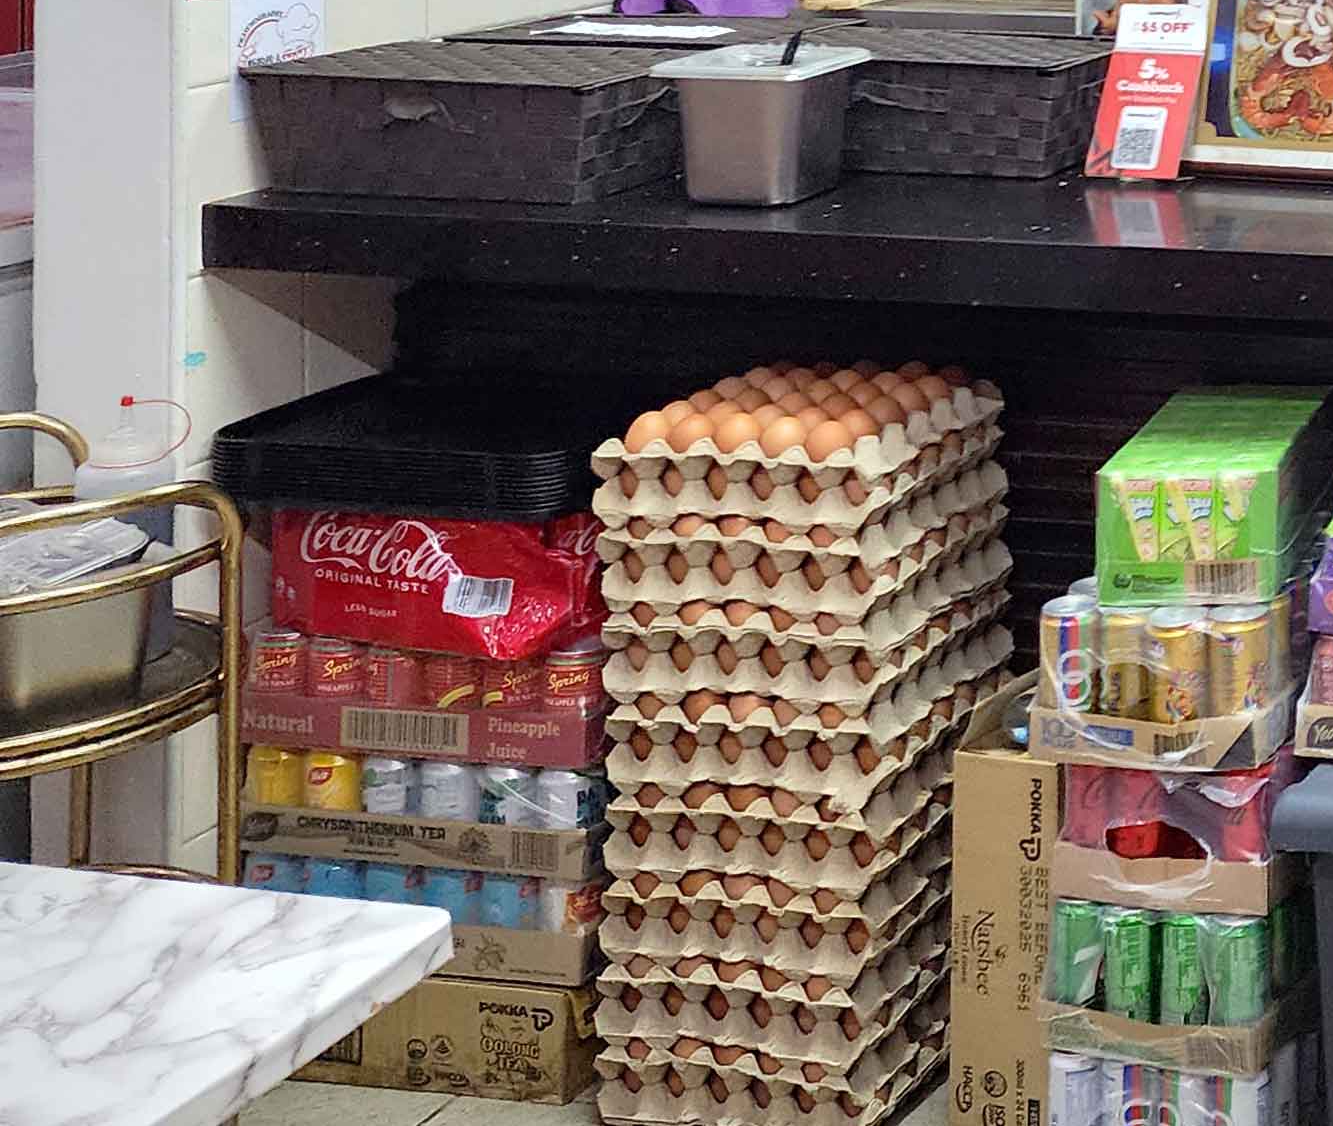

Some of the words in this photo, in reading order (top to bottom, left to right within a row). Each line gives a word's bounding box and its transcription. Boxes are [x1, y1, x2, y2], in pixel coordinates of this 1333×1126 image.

[300, 511, 465, 583] Coca-Cola
[314, 568, 382, 589] ORIGINAL
[386, 579, 430, 595] TASTE
[548, 670, 591, 692] Spring
[241, 712, 314, 735] Natural
[488, 717, 562, 738] Pineapple
[485, 744, 528, 760] Juice
[1029, 777, 1043, 838] POKKA
[479, 1001, 529, 1020] POKKA
